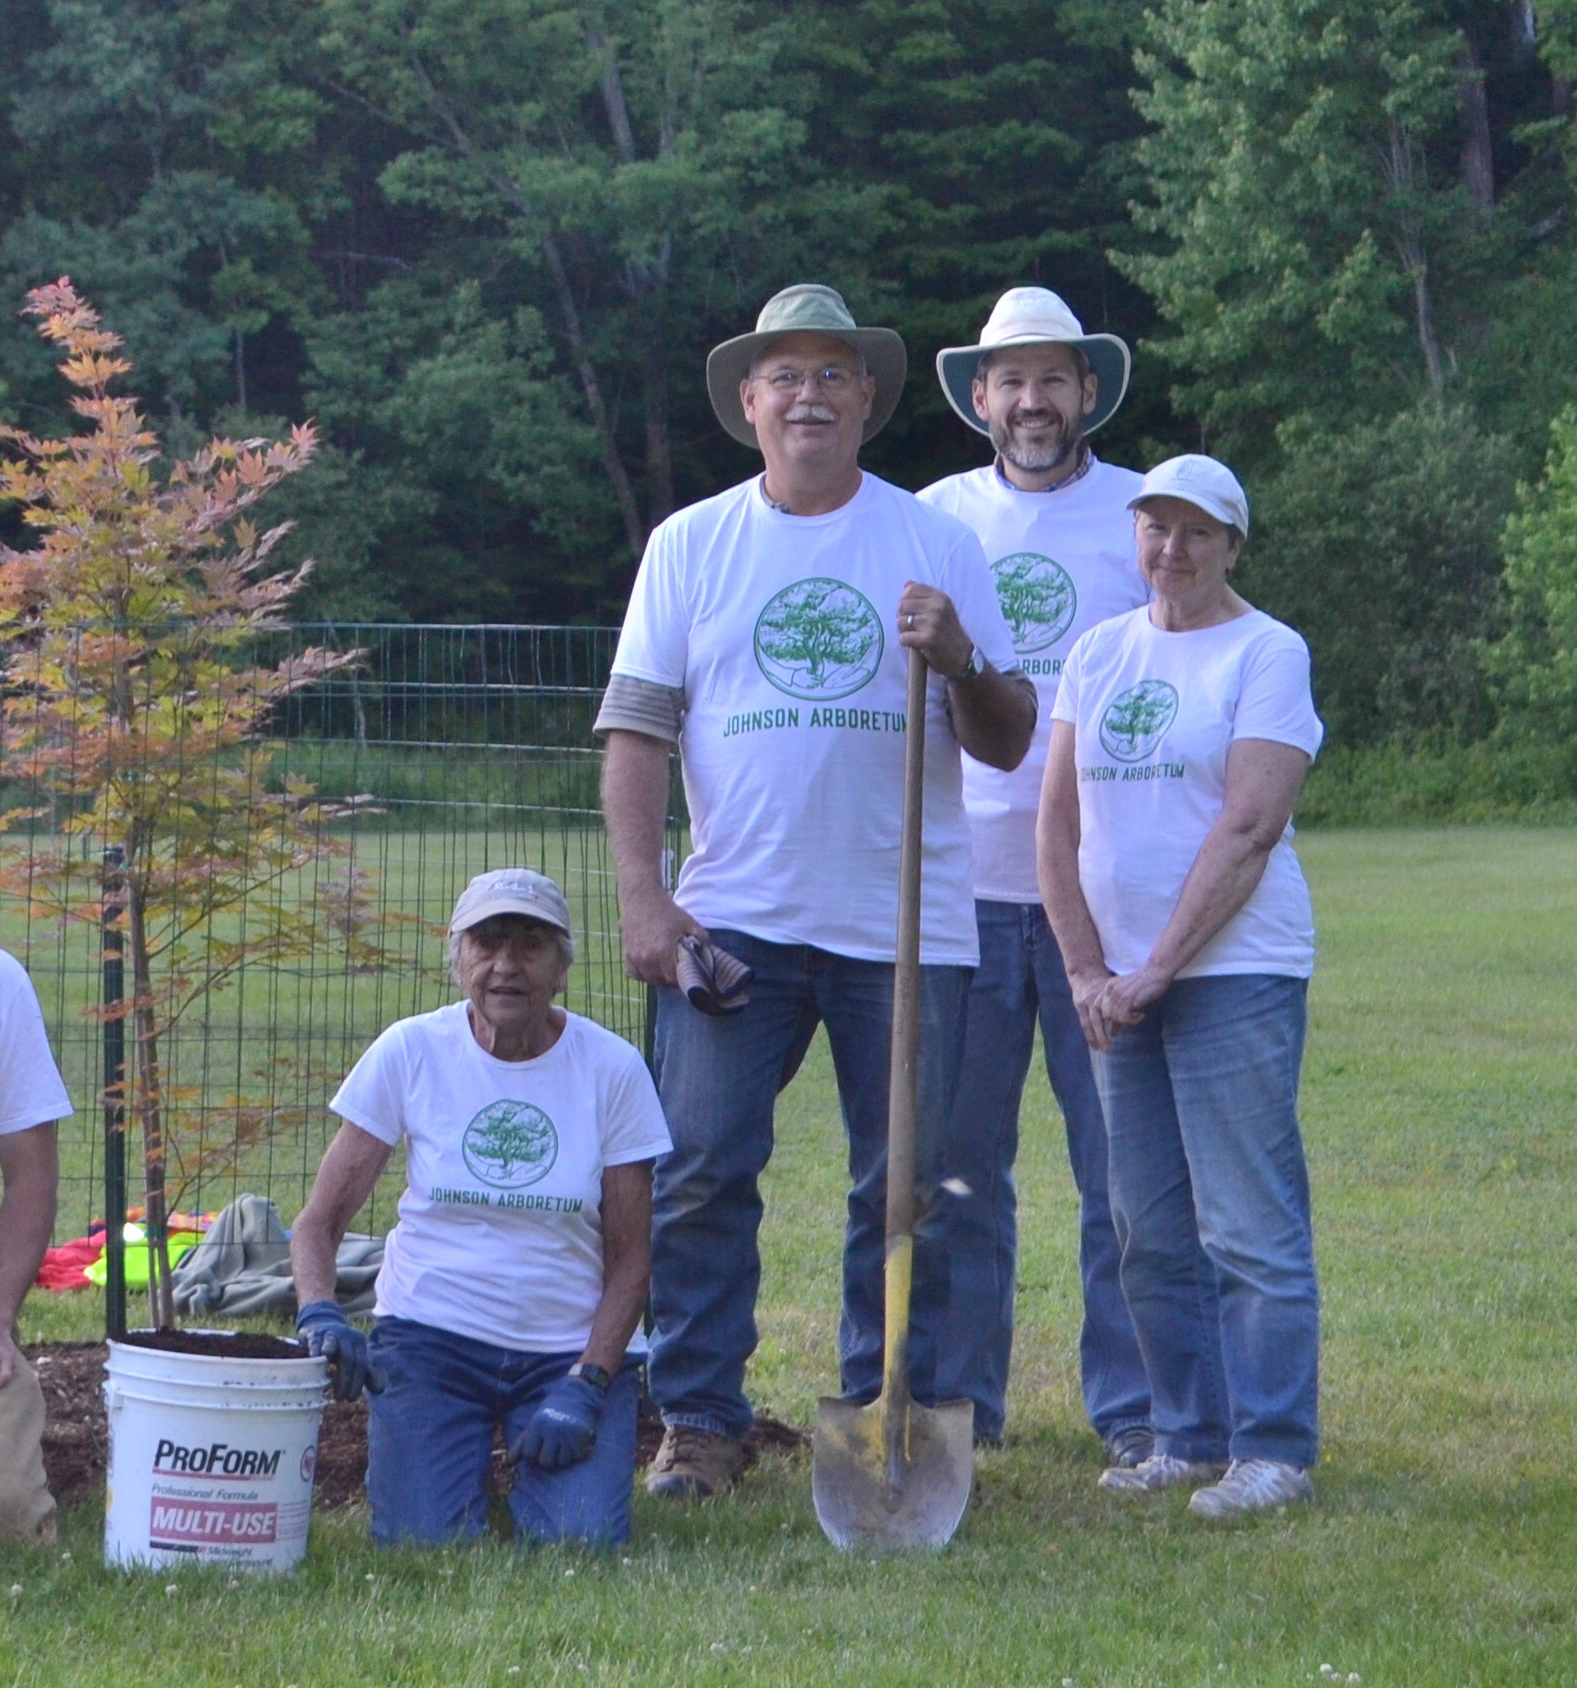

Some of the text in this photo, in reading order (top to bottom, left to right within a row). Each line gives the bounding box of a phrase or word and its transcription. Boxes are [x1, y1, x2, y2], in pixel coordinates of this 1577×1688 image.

[1016, 658, 1067, 675] RBOR
[723, 707, 800, 737] JOHNSON
[1122, 763, 1186, 782] ARBORETUM
[428, 1187, 583, 1213] JOHNSON ARBORETUM
[152, 1482, 259, 1501] Professional Formula
[152, 1505, 276, 1536] MULTI-USE
